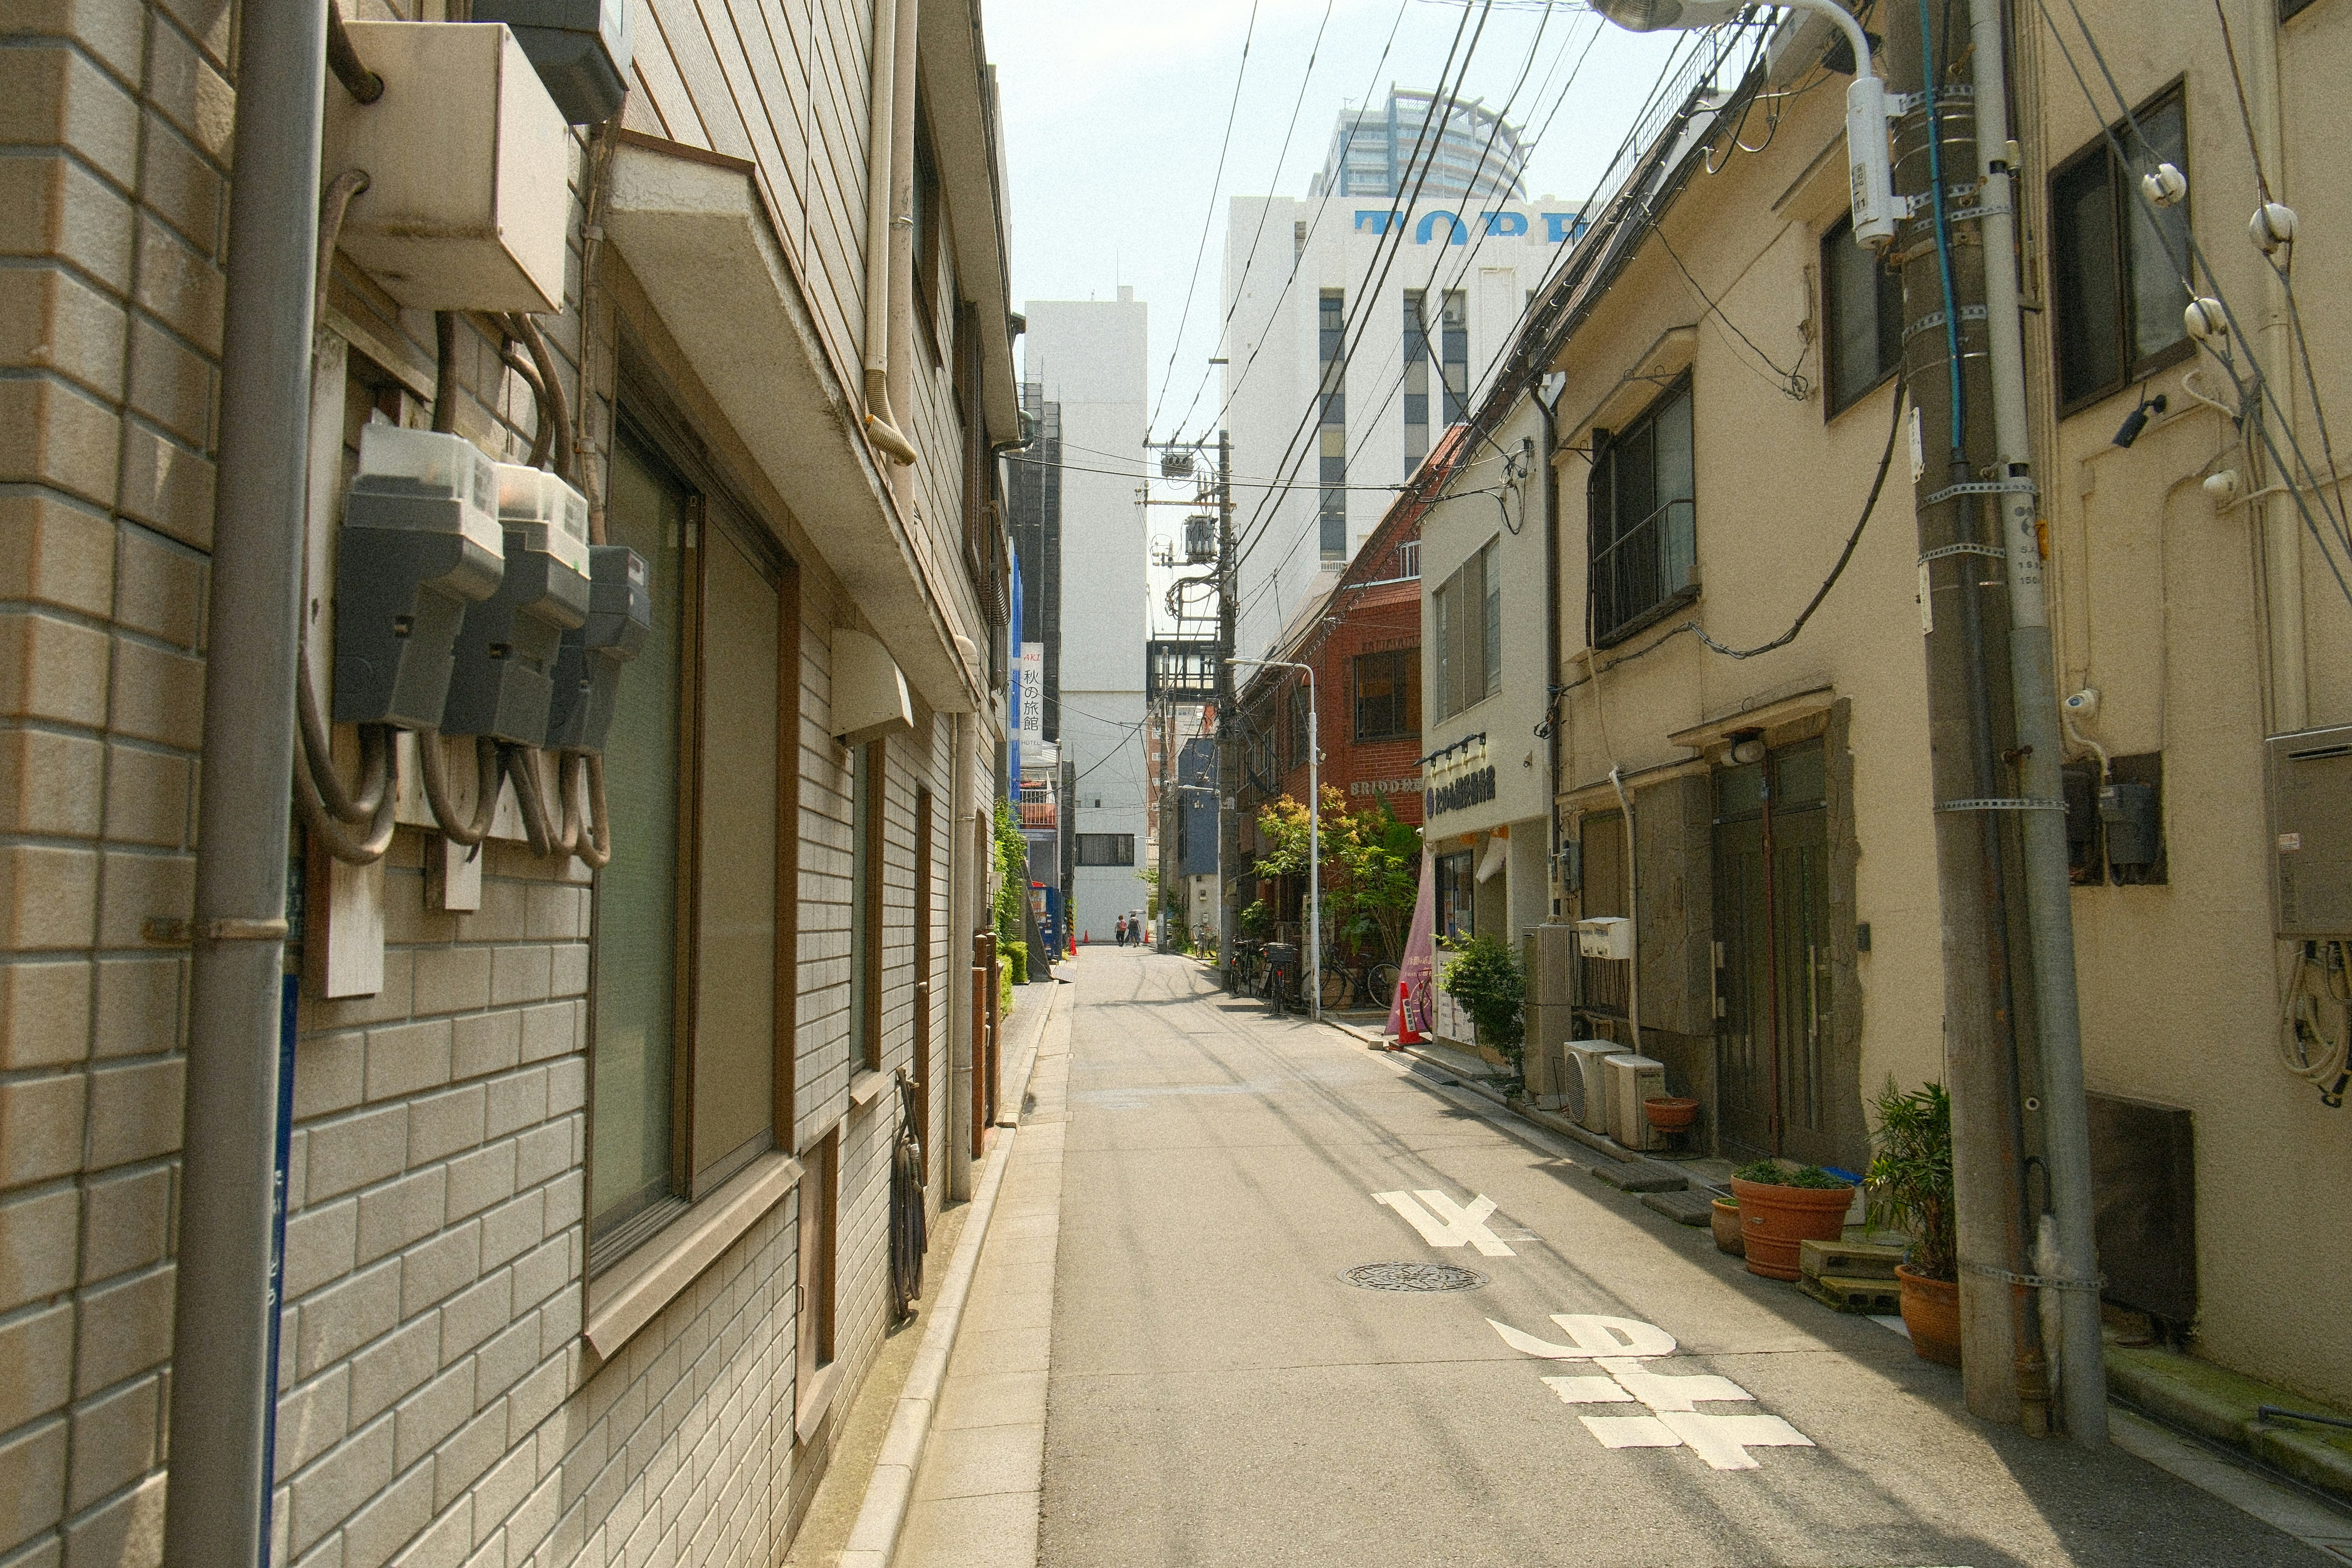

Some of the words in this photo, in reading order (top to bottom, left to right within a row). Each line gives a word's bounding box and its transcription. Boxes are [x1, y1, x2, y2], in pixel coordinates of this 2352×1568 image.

[1024, 669, 1039, 731] 秋の旅館
[1406, 1008, 1414, 1031] 駐車禁止
